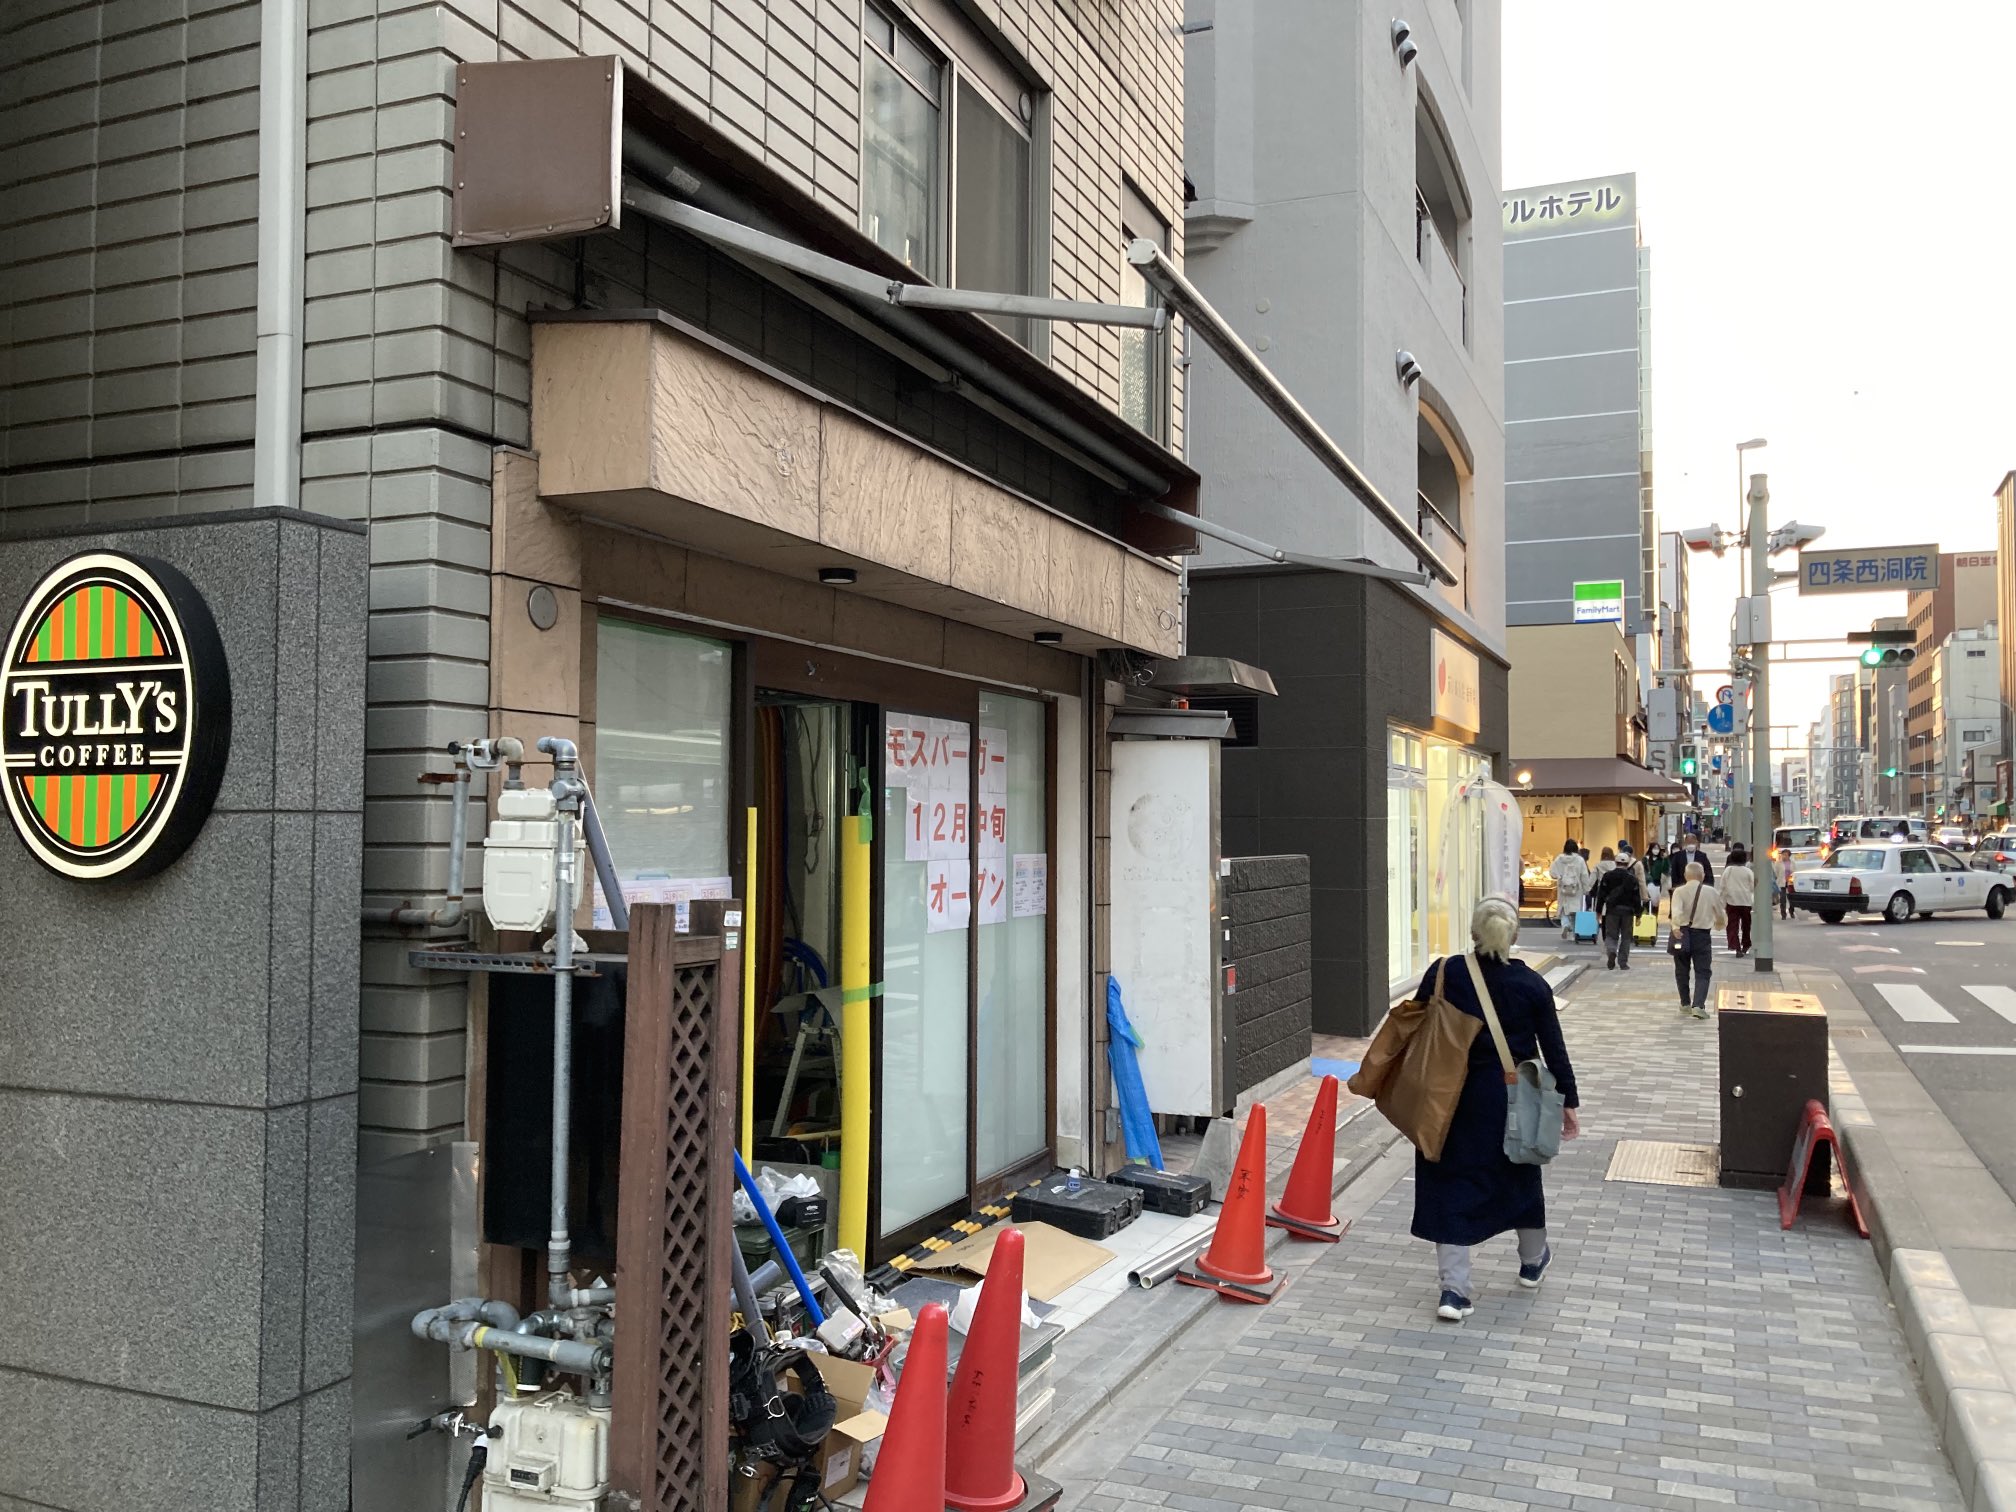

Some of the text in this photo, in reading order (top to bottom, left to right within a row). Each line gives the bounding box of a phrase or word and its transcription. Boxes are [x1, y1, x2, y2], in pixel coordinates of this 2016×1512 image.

[1808, 555, 1928, 586] 四条西洞院
[1576, 605, 1621, 615] FamilyMart
[40, 743, 145, 768] COFFEE
[887, 729, 1005, 776] モスバーガー
[930, 868, 1005, 914] オープン
